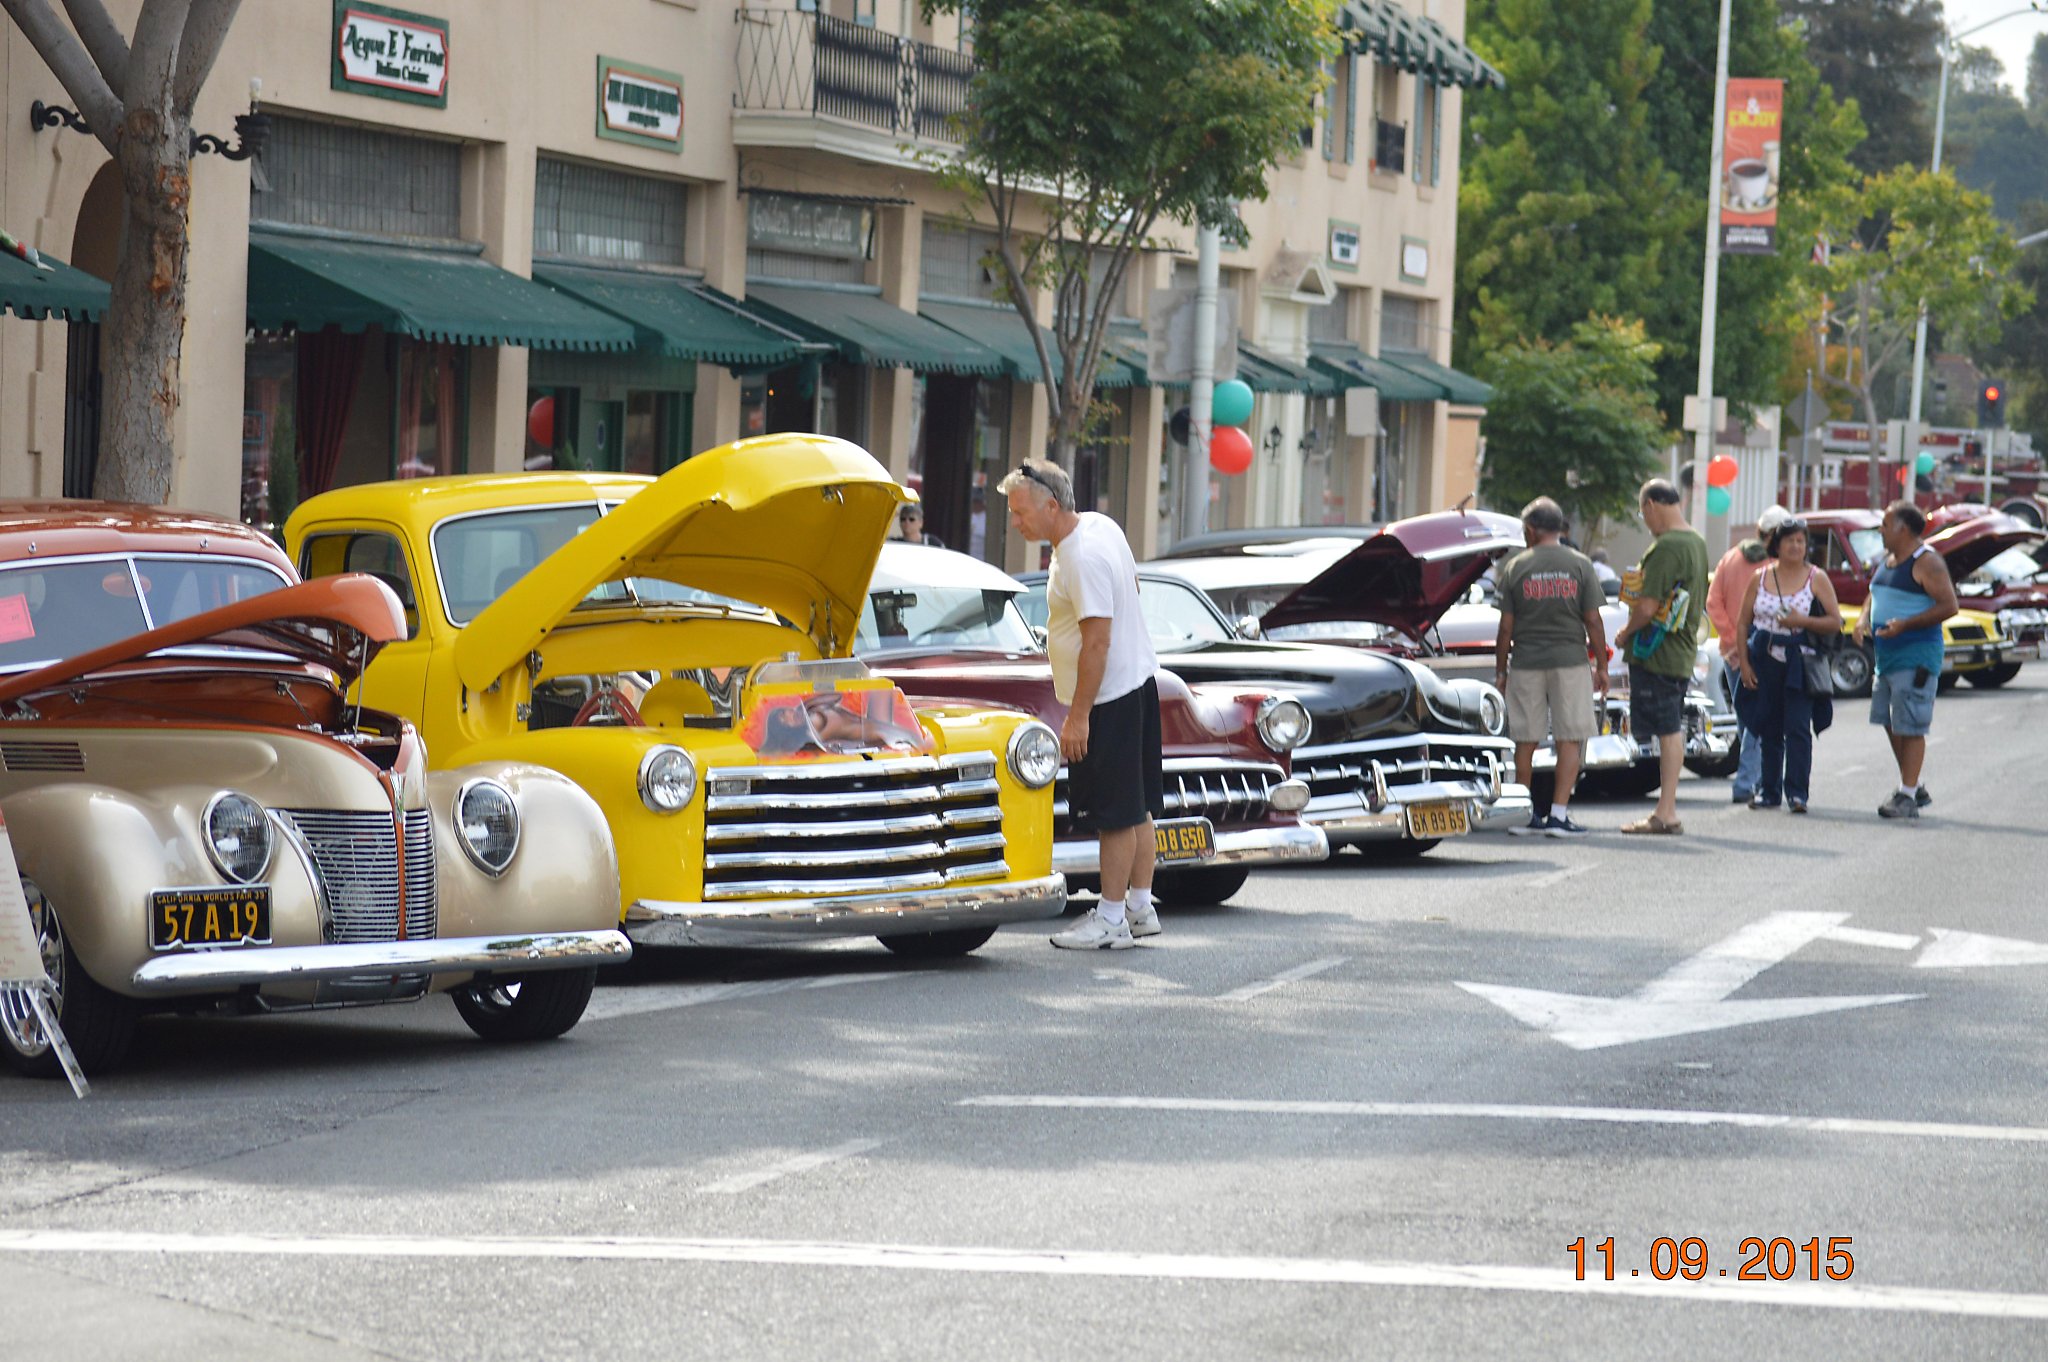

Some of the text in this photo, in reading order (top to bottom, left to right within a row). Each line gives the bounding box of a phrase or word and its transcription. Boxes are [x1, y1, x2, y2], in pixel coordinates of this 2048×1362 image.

[1728, 110, 1778, 128] ENJOY
[1523, 579, 1578, 600] SQUATCH
[1168, 828, 1179, 852] 8
[1179, 825, 1207, 851] 650
[156, 892, 202, 905] CALIFORNIA
[236, 888, 253, 901] FAIR
[164, 900, 259, 942] 57 A 19
